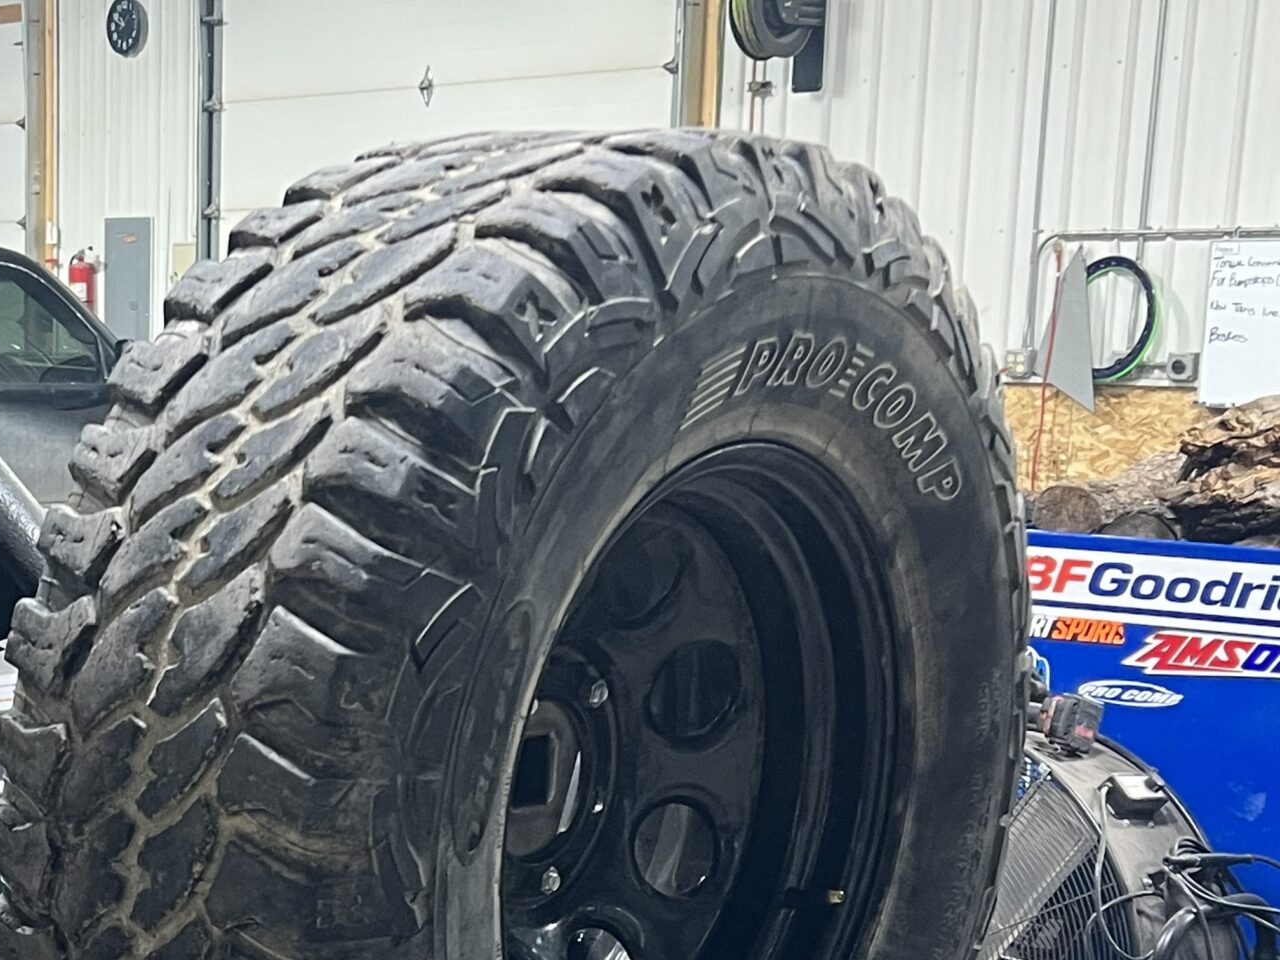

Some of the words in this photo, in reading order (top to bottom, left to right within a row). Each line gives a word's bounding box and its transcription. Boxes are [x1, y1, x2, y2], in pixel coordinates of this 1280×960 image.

[1026, 555, 1280, 612] BFGoodri
[1078, 685, 1122, 699] PRO
[1121, 689, 1184, 704] COMP
